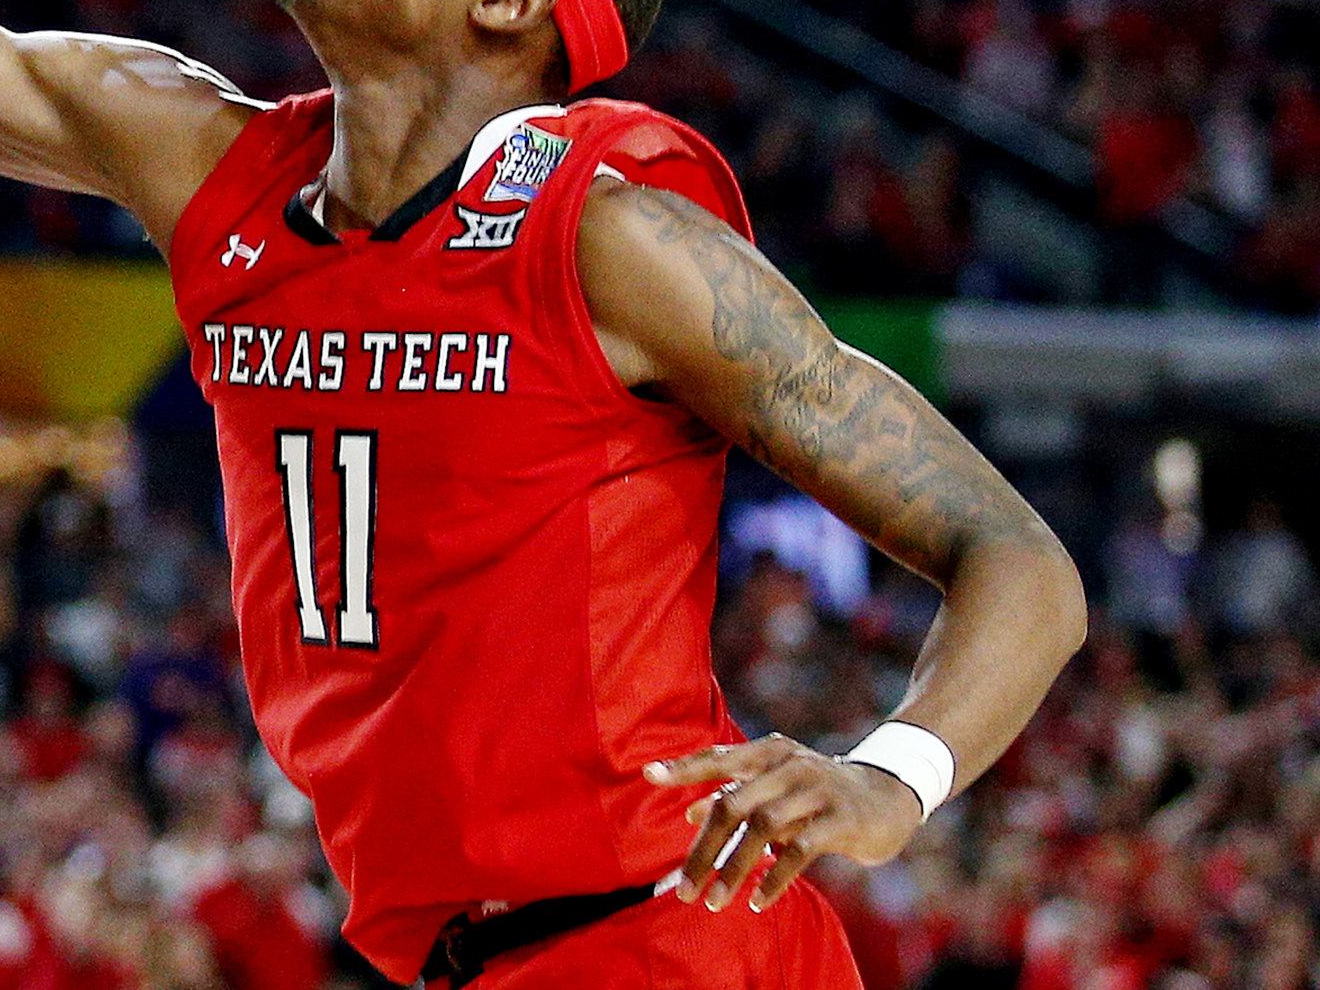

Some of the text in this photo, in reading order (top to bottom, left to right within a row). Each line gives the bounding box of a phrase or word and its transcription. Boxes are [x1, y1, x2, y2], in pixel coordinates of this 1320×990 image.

[201, 322, 512, 393] TEXAS TECH
[274, 428, 380, 651] 11
